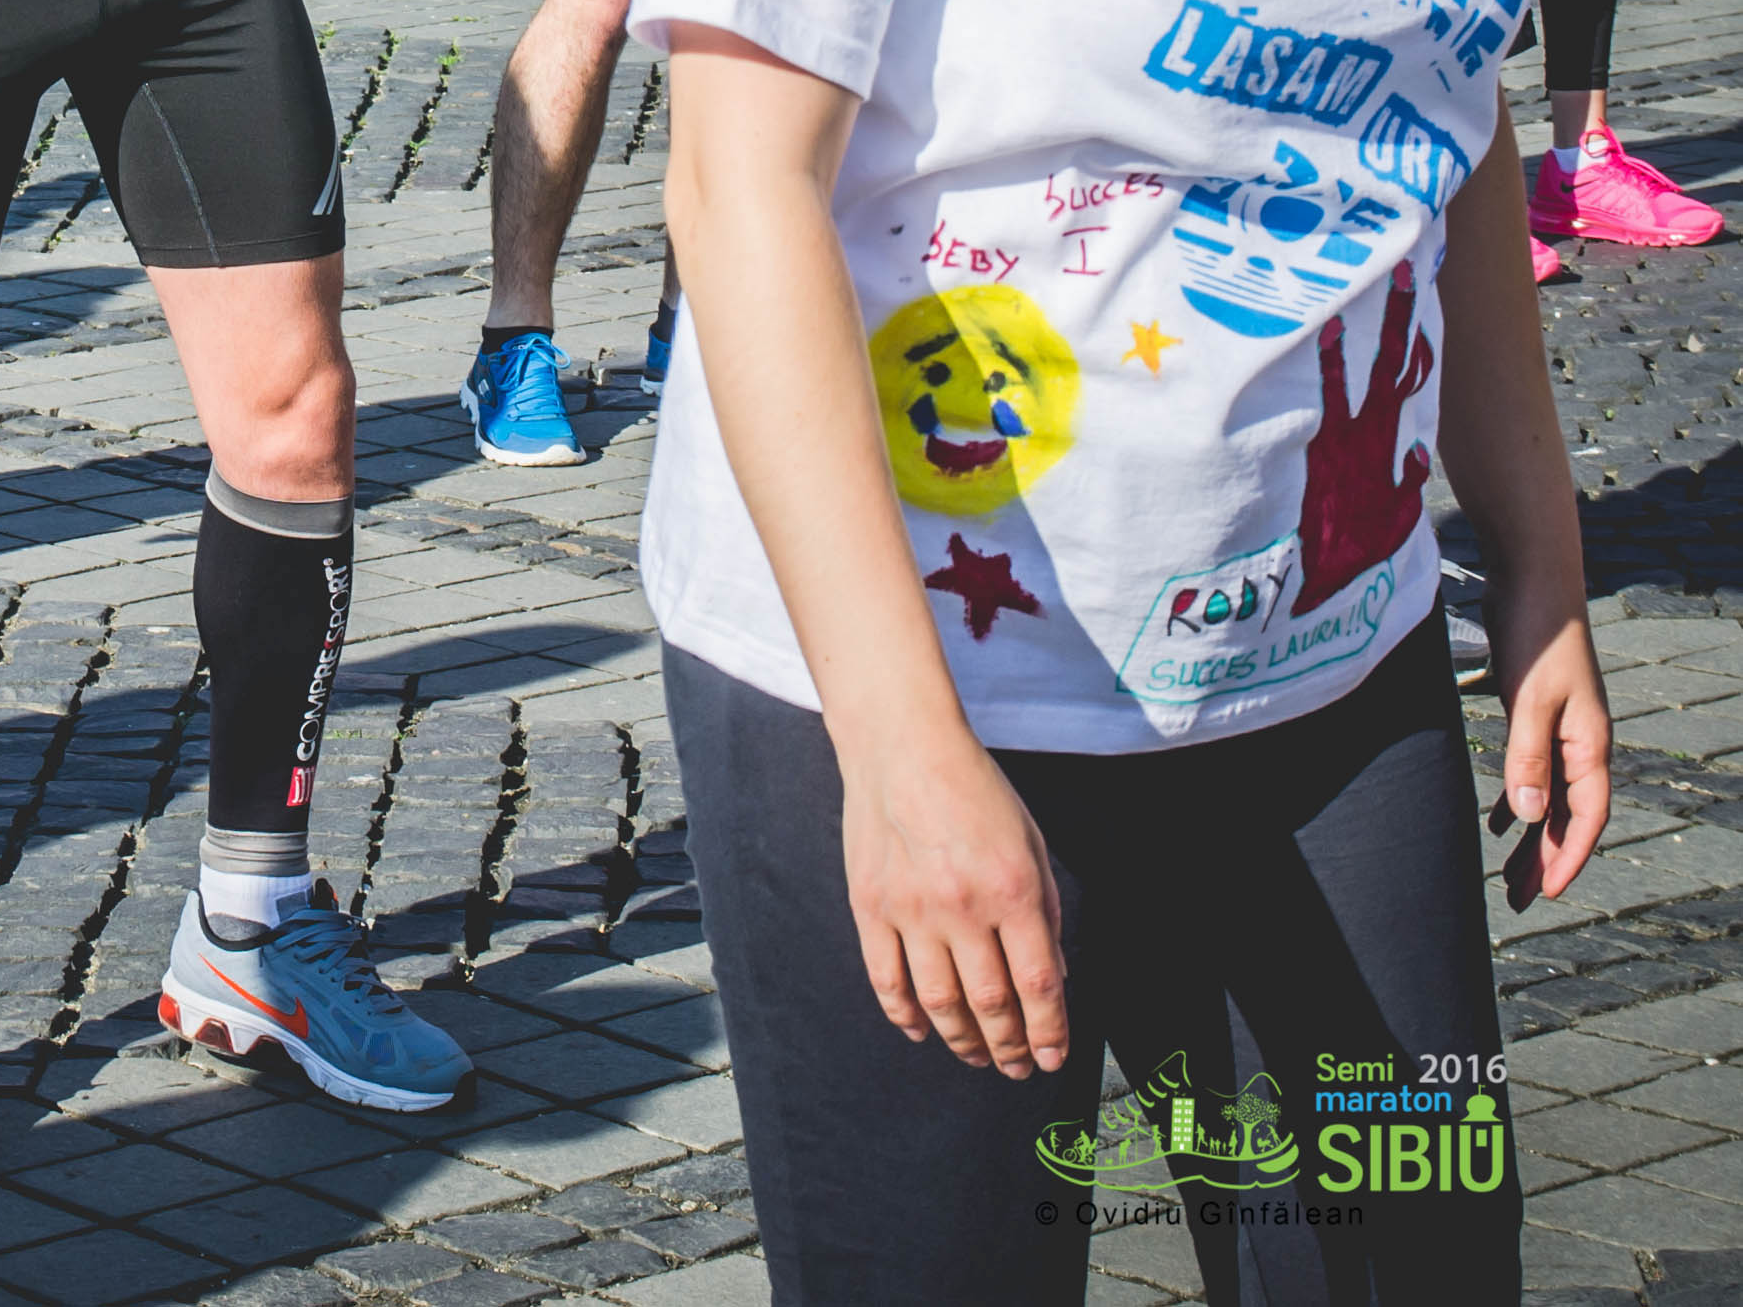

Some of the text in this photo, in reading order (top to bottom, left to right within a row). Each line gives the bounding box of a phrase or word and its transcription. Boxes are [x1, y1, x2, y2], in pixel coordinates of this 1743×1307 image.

[1362, 99, 1465, 207] URM
[1044, 173, 1164, 221] SUCCES
[1146, 649, 1258, 691] SUCCES
